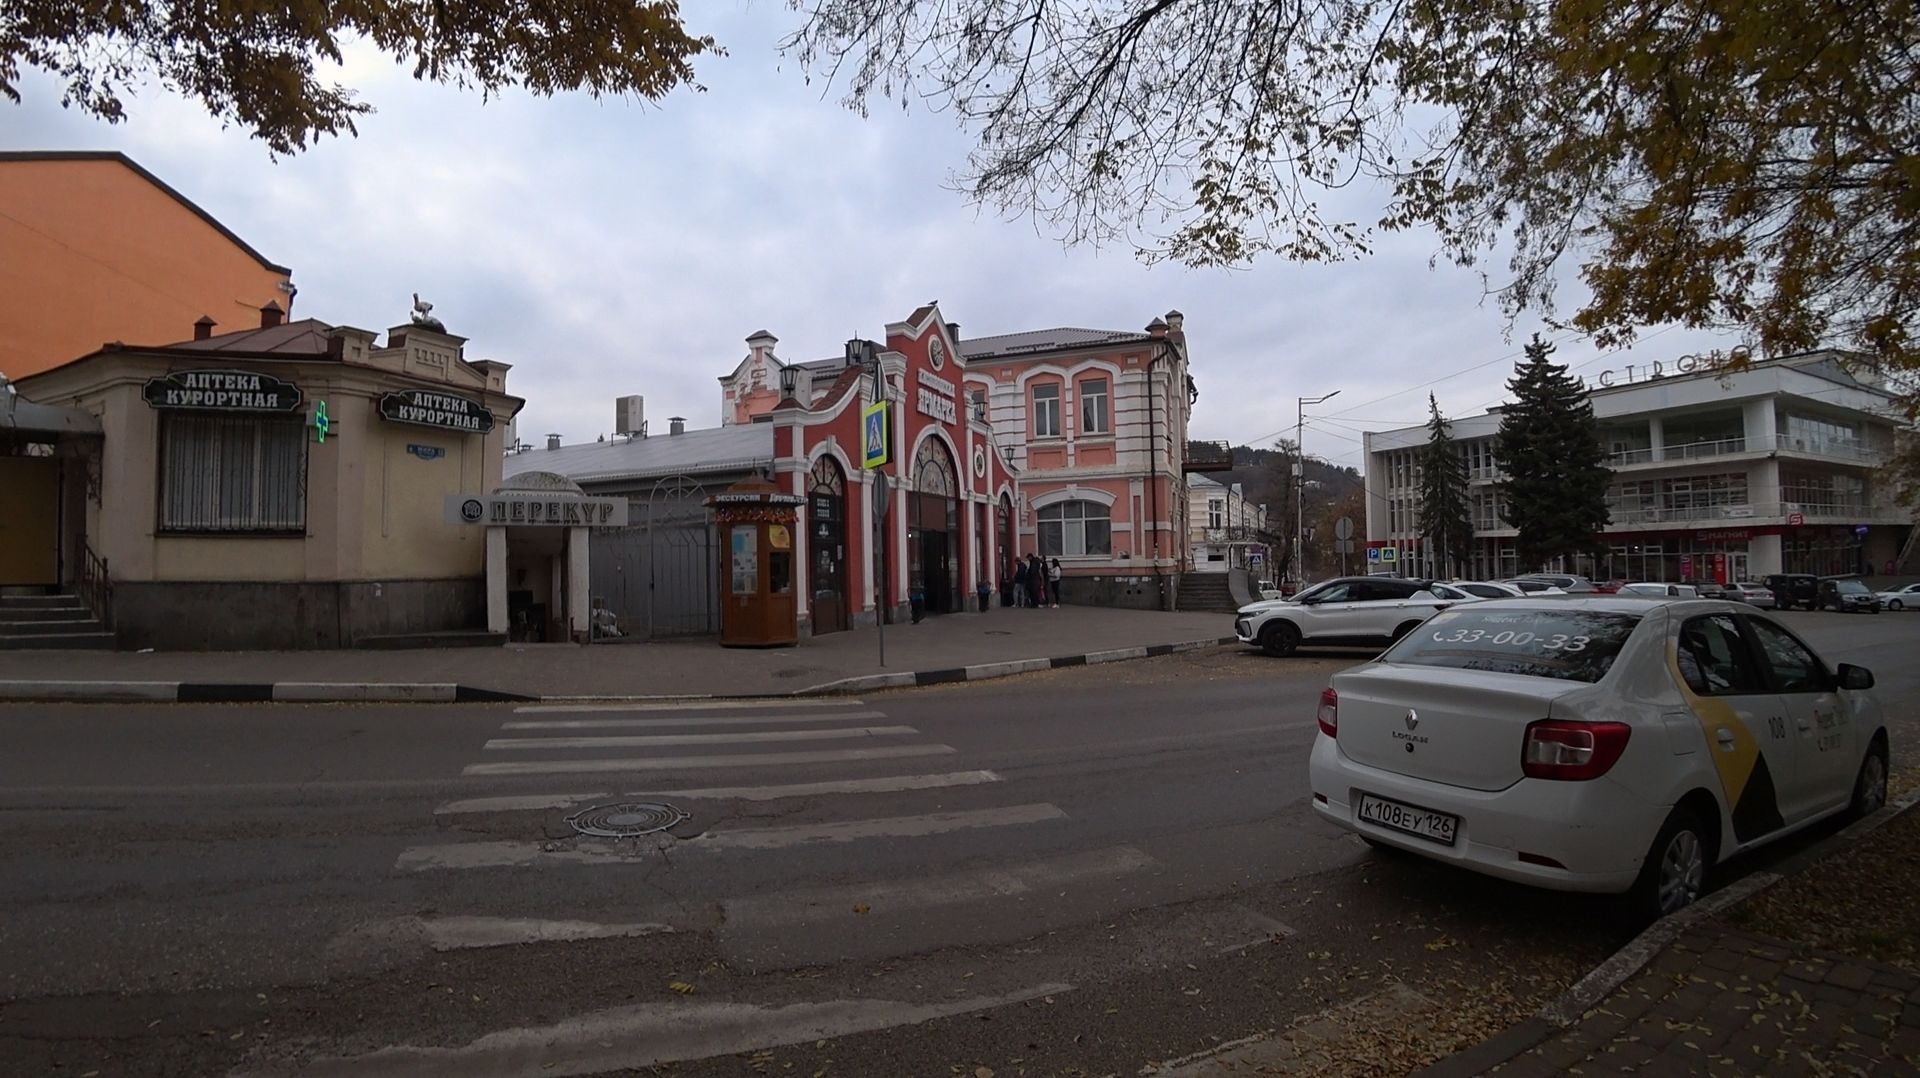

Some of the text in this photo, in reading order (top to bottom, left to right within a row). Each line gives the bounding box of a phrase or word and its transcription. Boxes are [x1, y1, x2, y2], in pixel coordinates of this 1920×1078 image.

[184, 373, 261, 390] АПТЕКА
[166, 390, 279, 408] КУРОРТНАЯ
[413, 392, 469, 414] АПТЕКА
[398, 405, 480, 430] КУРОРТНАЯ
[489, 501, 614, 523] ПЕРЕКУР
[1446, 629, 1591, 651] 33-00-33
[1392, 730, 1429, 744] LOGAN
[1426, 814, 1451, 833] 126
